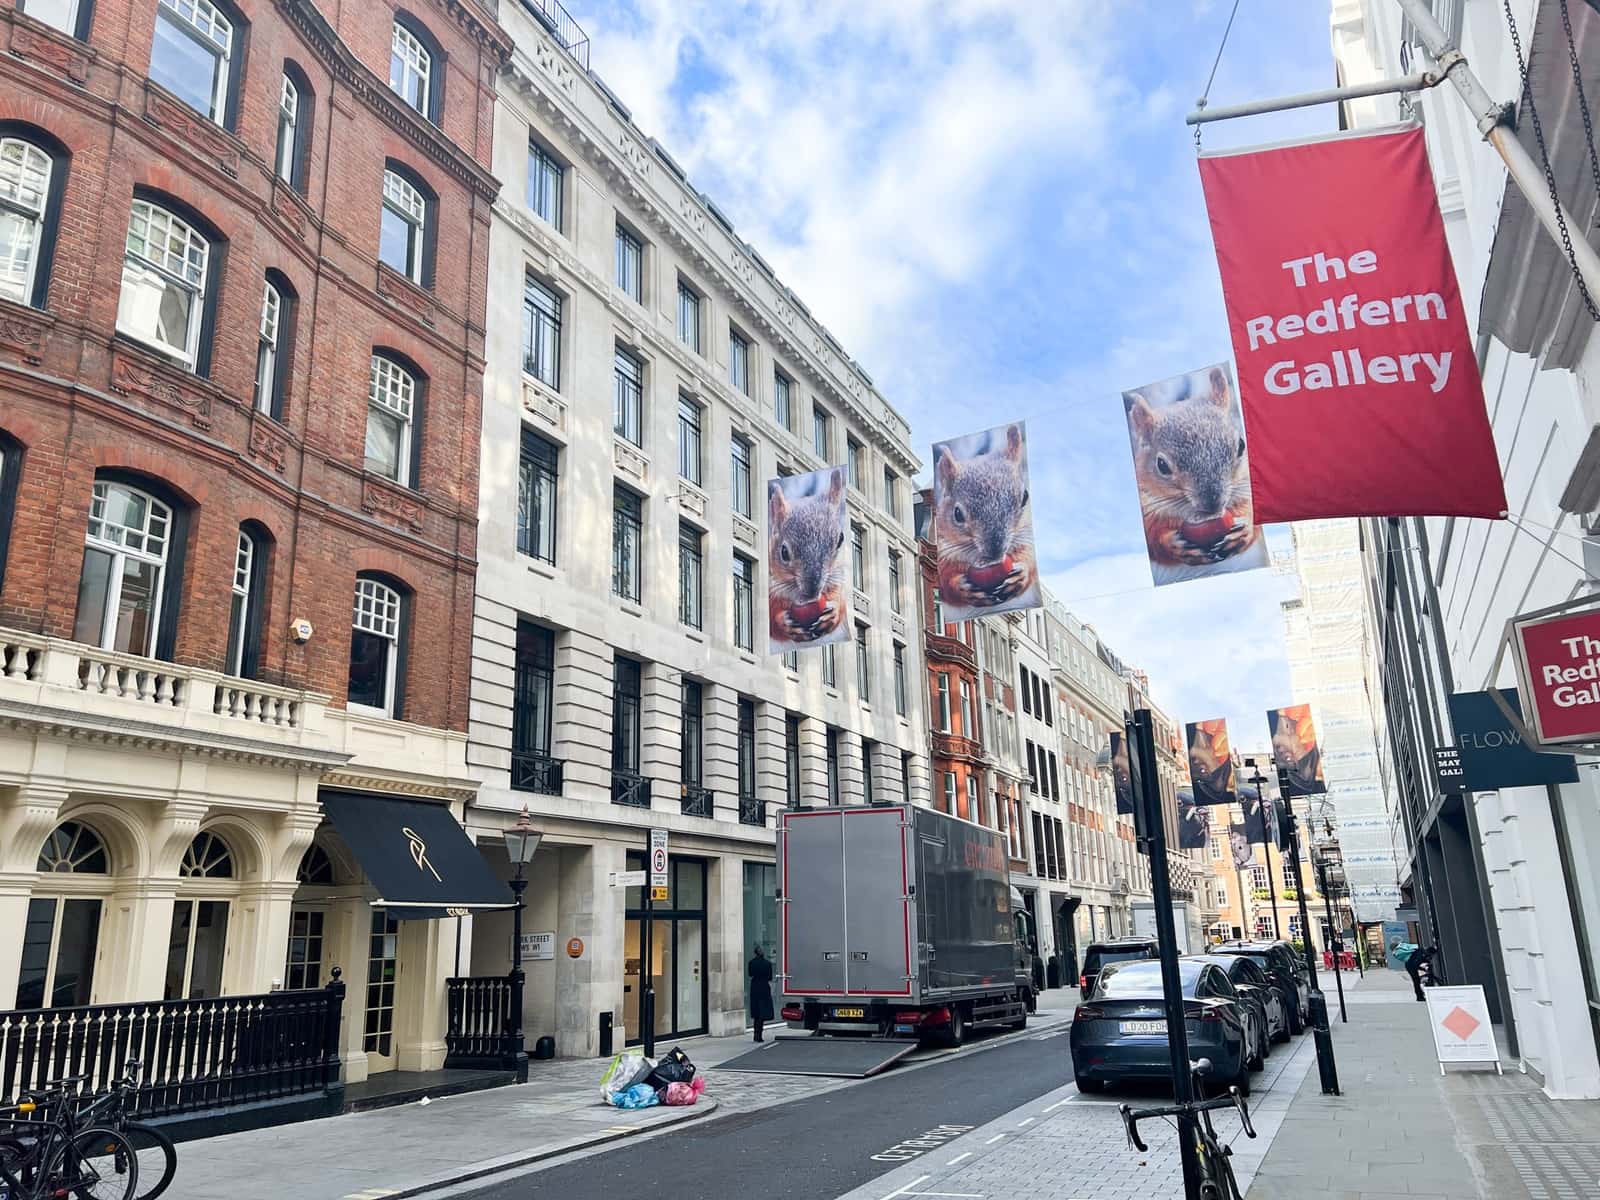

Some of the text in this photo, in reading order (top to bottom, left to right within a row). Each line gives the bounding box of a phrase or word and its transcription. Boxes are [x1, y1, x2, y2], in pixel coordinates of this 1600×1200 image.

[1282, 250, 1377, 287] The
[1246, 292, 1448, 351] Redfern
[1263, 348, 1453, 396] Gallery
[1553, 681, 1600, 707] Gal
[1436, 750, 1458, 758] THE
[870, 1124, 976, 1161] DISABLED
